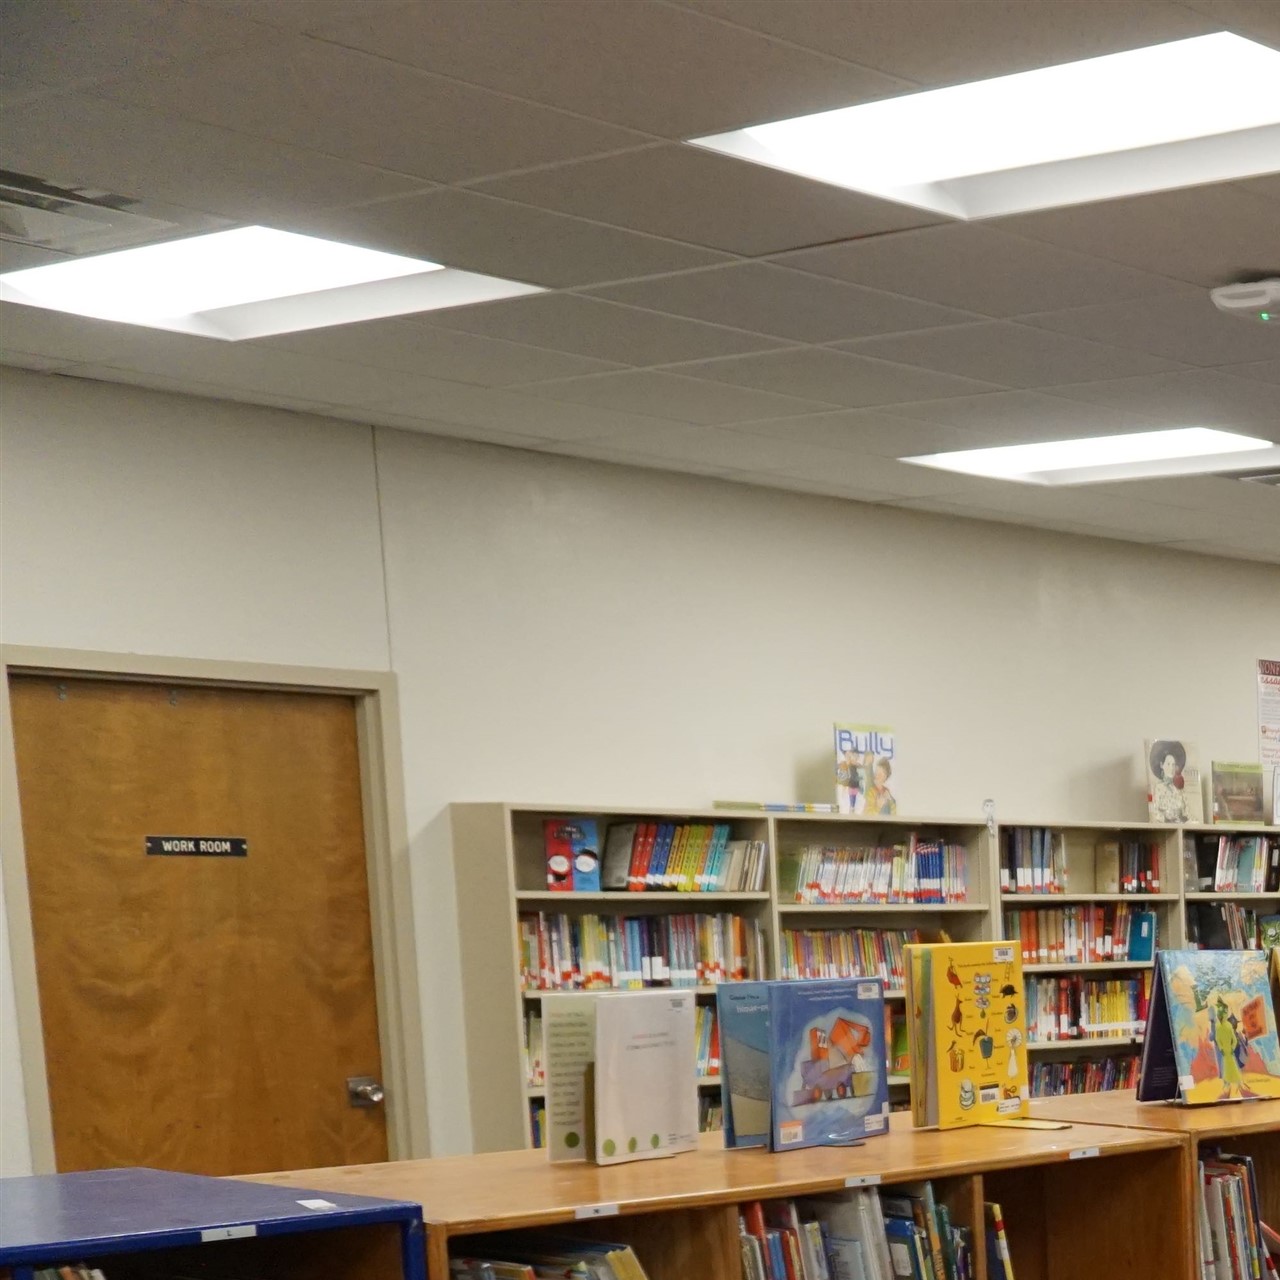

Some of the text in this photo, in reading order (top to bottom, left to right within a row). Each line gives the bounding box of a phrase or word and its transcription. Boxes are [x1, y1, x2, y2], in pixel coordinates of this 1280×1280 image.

[838, 729, 894, 760] Bully
[161, 840, 231, 853] WORK ROOM
